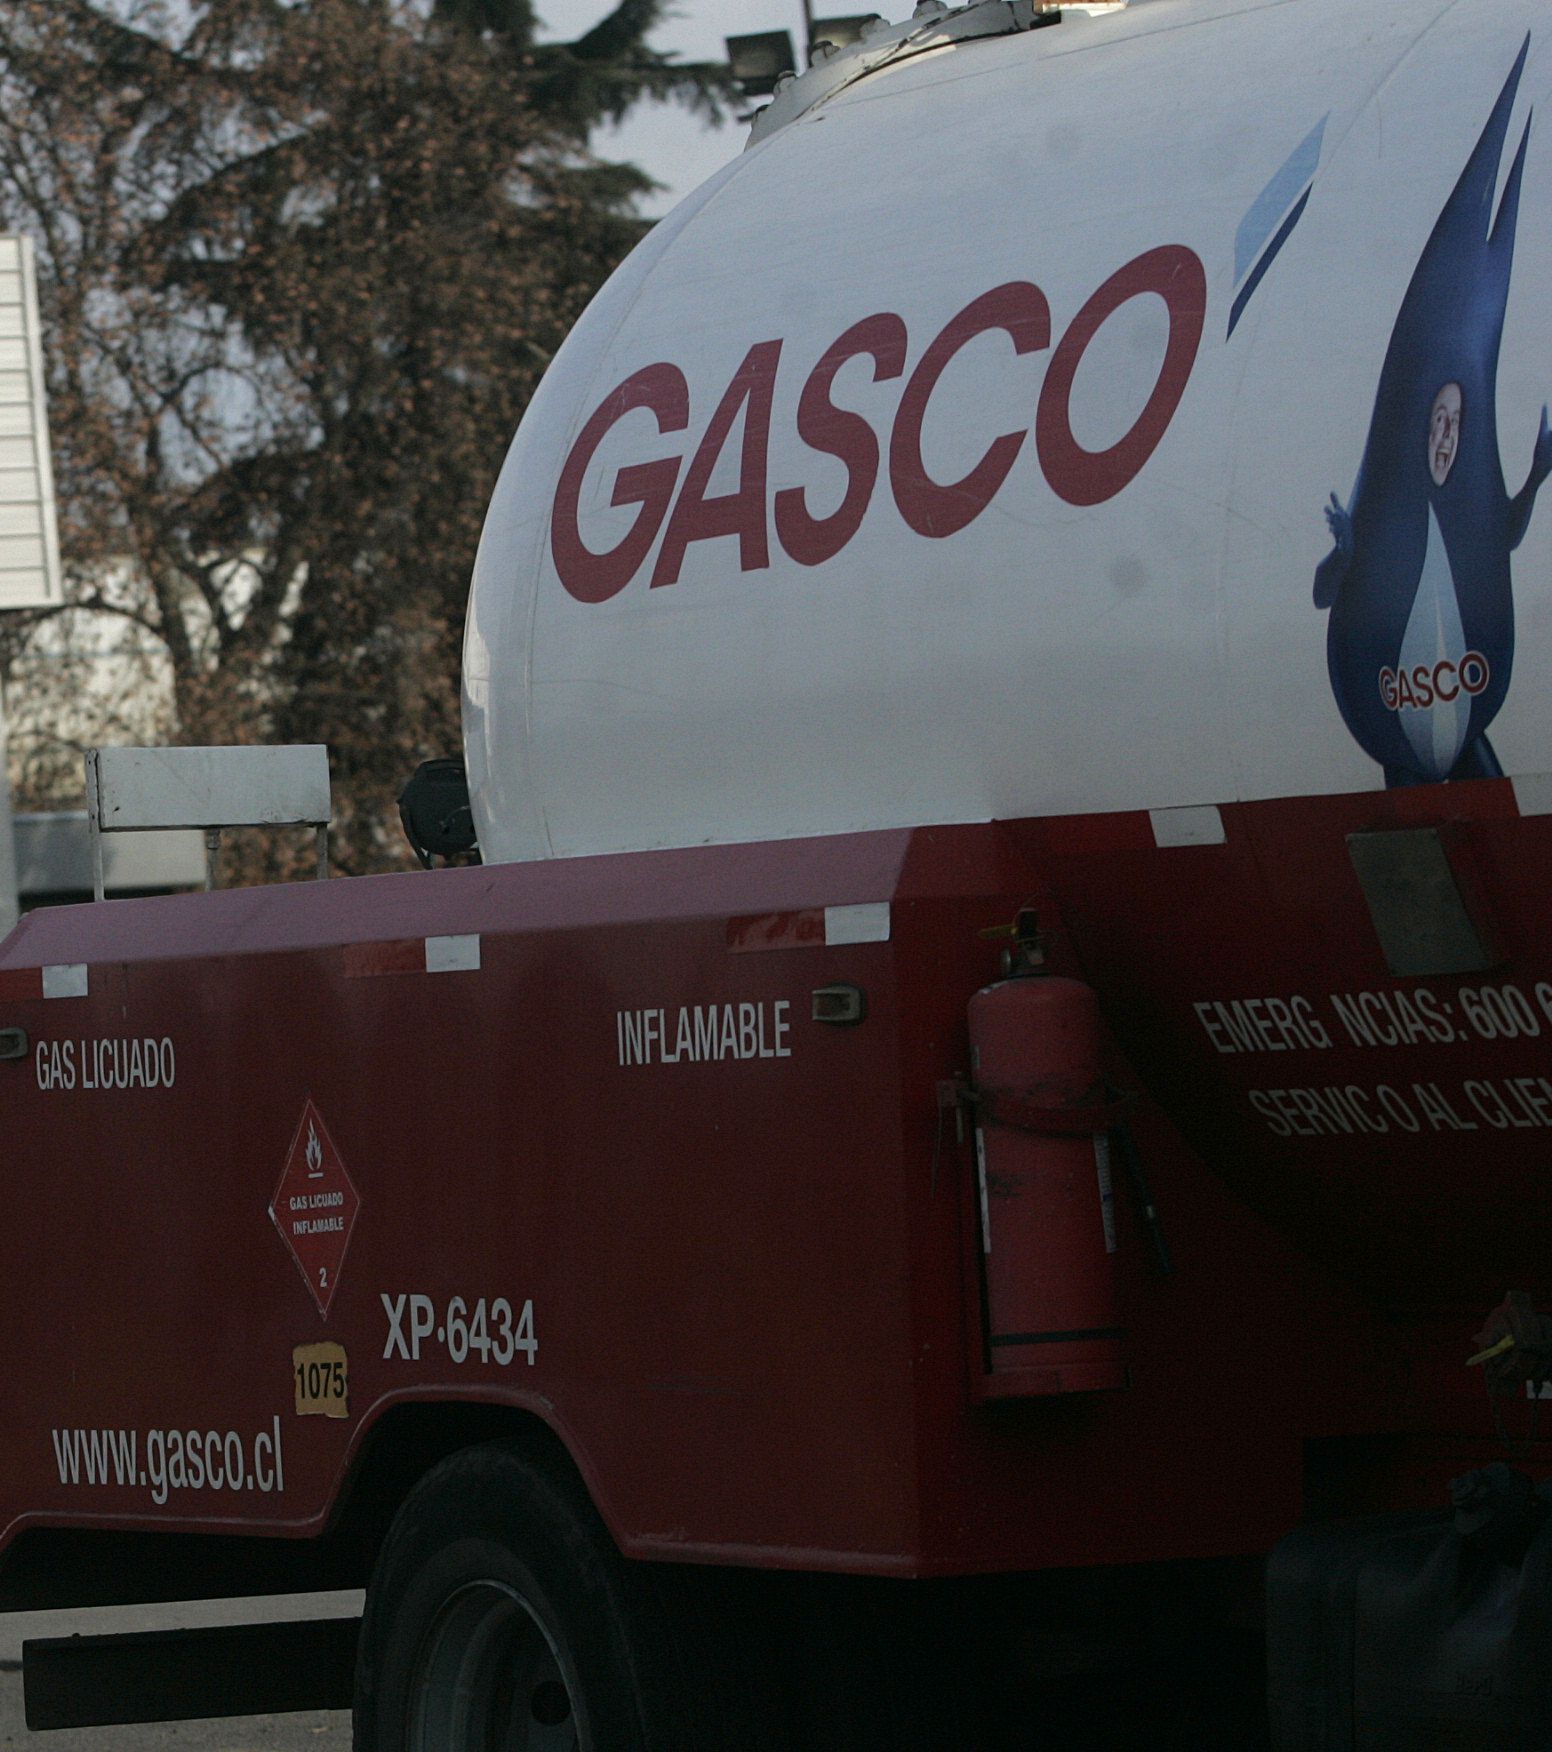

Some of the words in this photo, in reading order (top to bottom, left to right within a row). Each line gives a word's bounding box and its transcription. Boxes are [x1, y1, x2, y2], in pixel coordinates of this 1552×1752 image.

[550, 243, 1207, 604] GASCO
[1379, 651, 1490, 711] GASCO
[616, 1000, 792, 1066] INFLAMABLE
[1458, 983, 1541, 1040] 600
[35, 1039, 77, 1090] GAS
[80, 1036, 176, 1089] LICUADO
[1412, 1082, 1478, 1131] AL
[289, 1195, 308, 1211] GAS
[309, 1191, 344, 1209] LICUADO
[292, 1216, 344, 1235] INFLAMABLE
[319, 1267, 329, 1289] 2
[297, 1361, 346, 1400] 1075
[51, 1414, 284, 1505] www.gasco.cl
